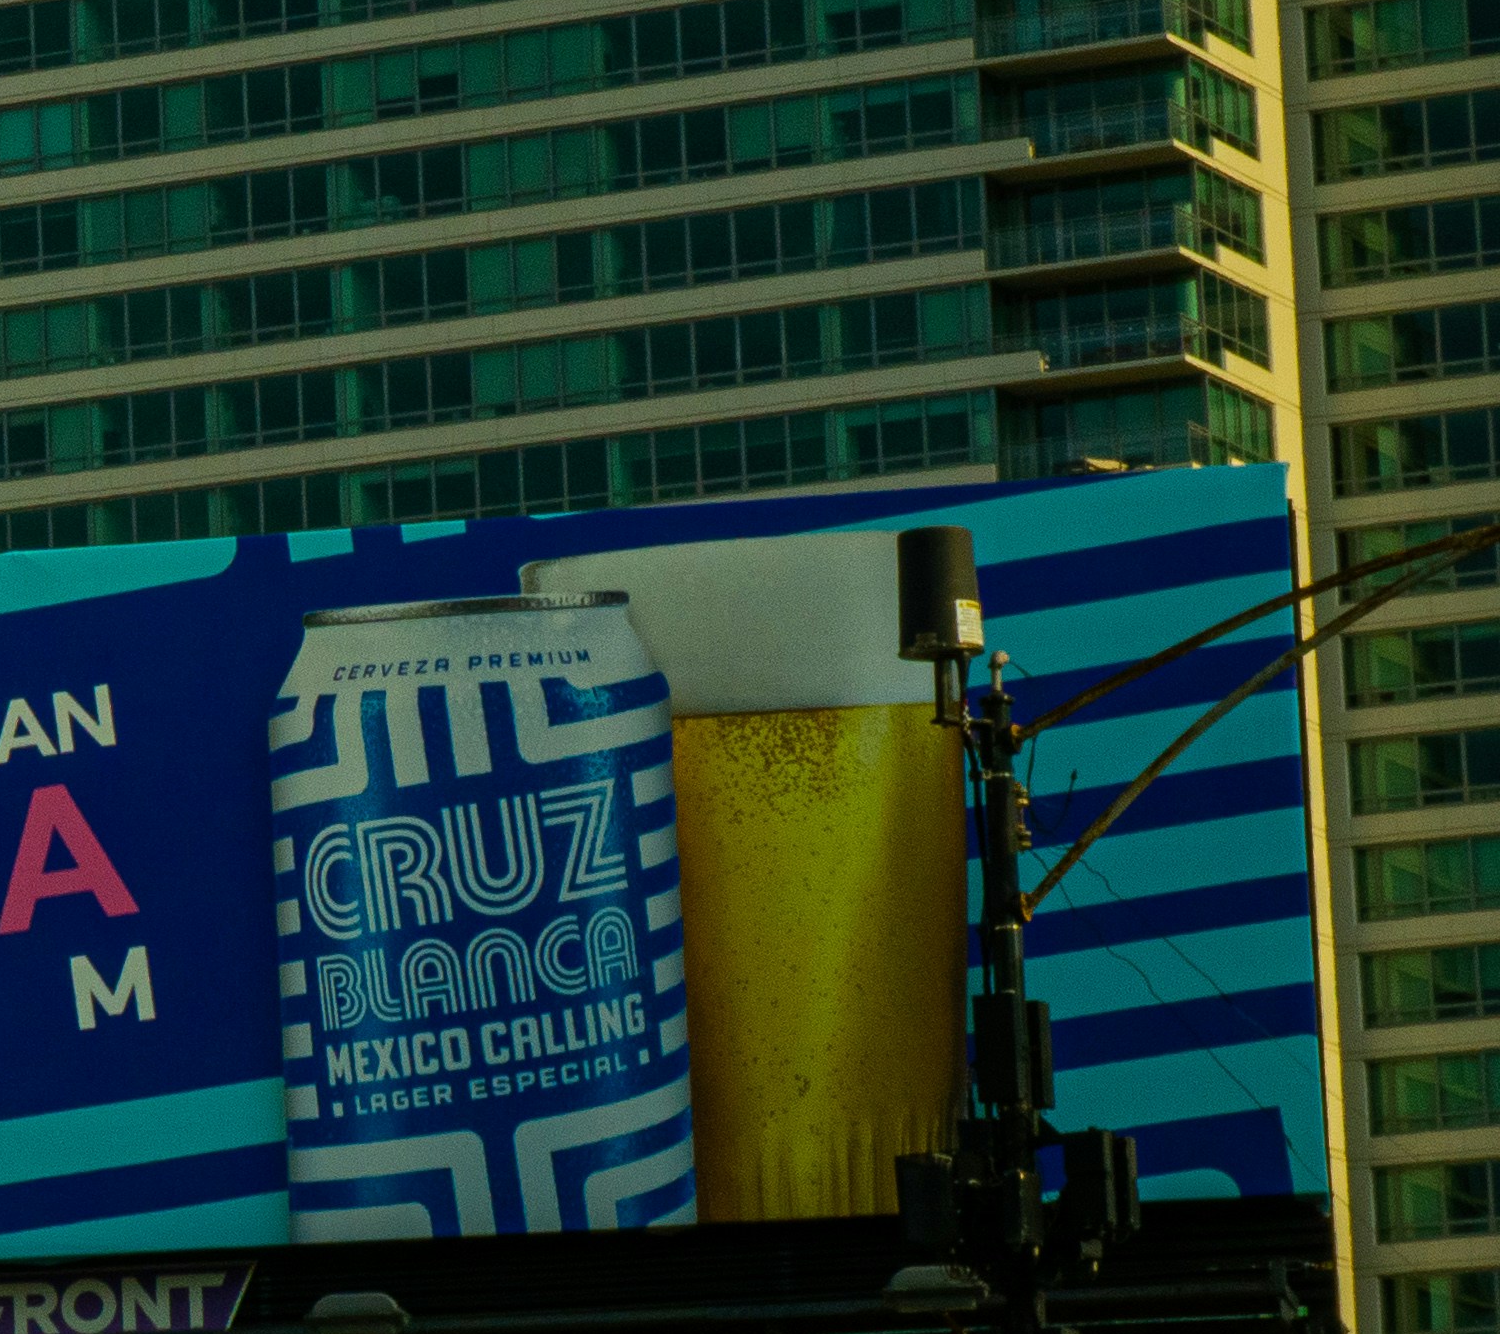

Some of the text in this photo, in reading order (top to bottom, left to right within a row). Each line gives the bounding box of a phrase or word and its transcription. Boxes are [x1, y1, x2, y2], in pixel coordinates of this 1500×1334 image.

[333, 647, 593, 682] CERVEZA PREMIUM
[304, 778, 628, 940] CRUZ
[316, 905, 642, 1031] BLANCA
[325, 993, 647, 1088] MEXICO CALLING
[354, 1055, 629, 1117] LAGER ESPECIAL
